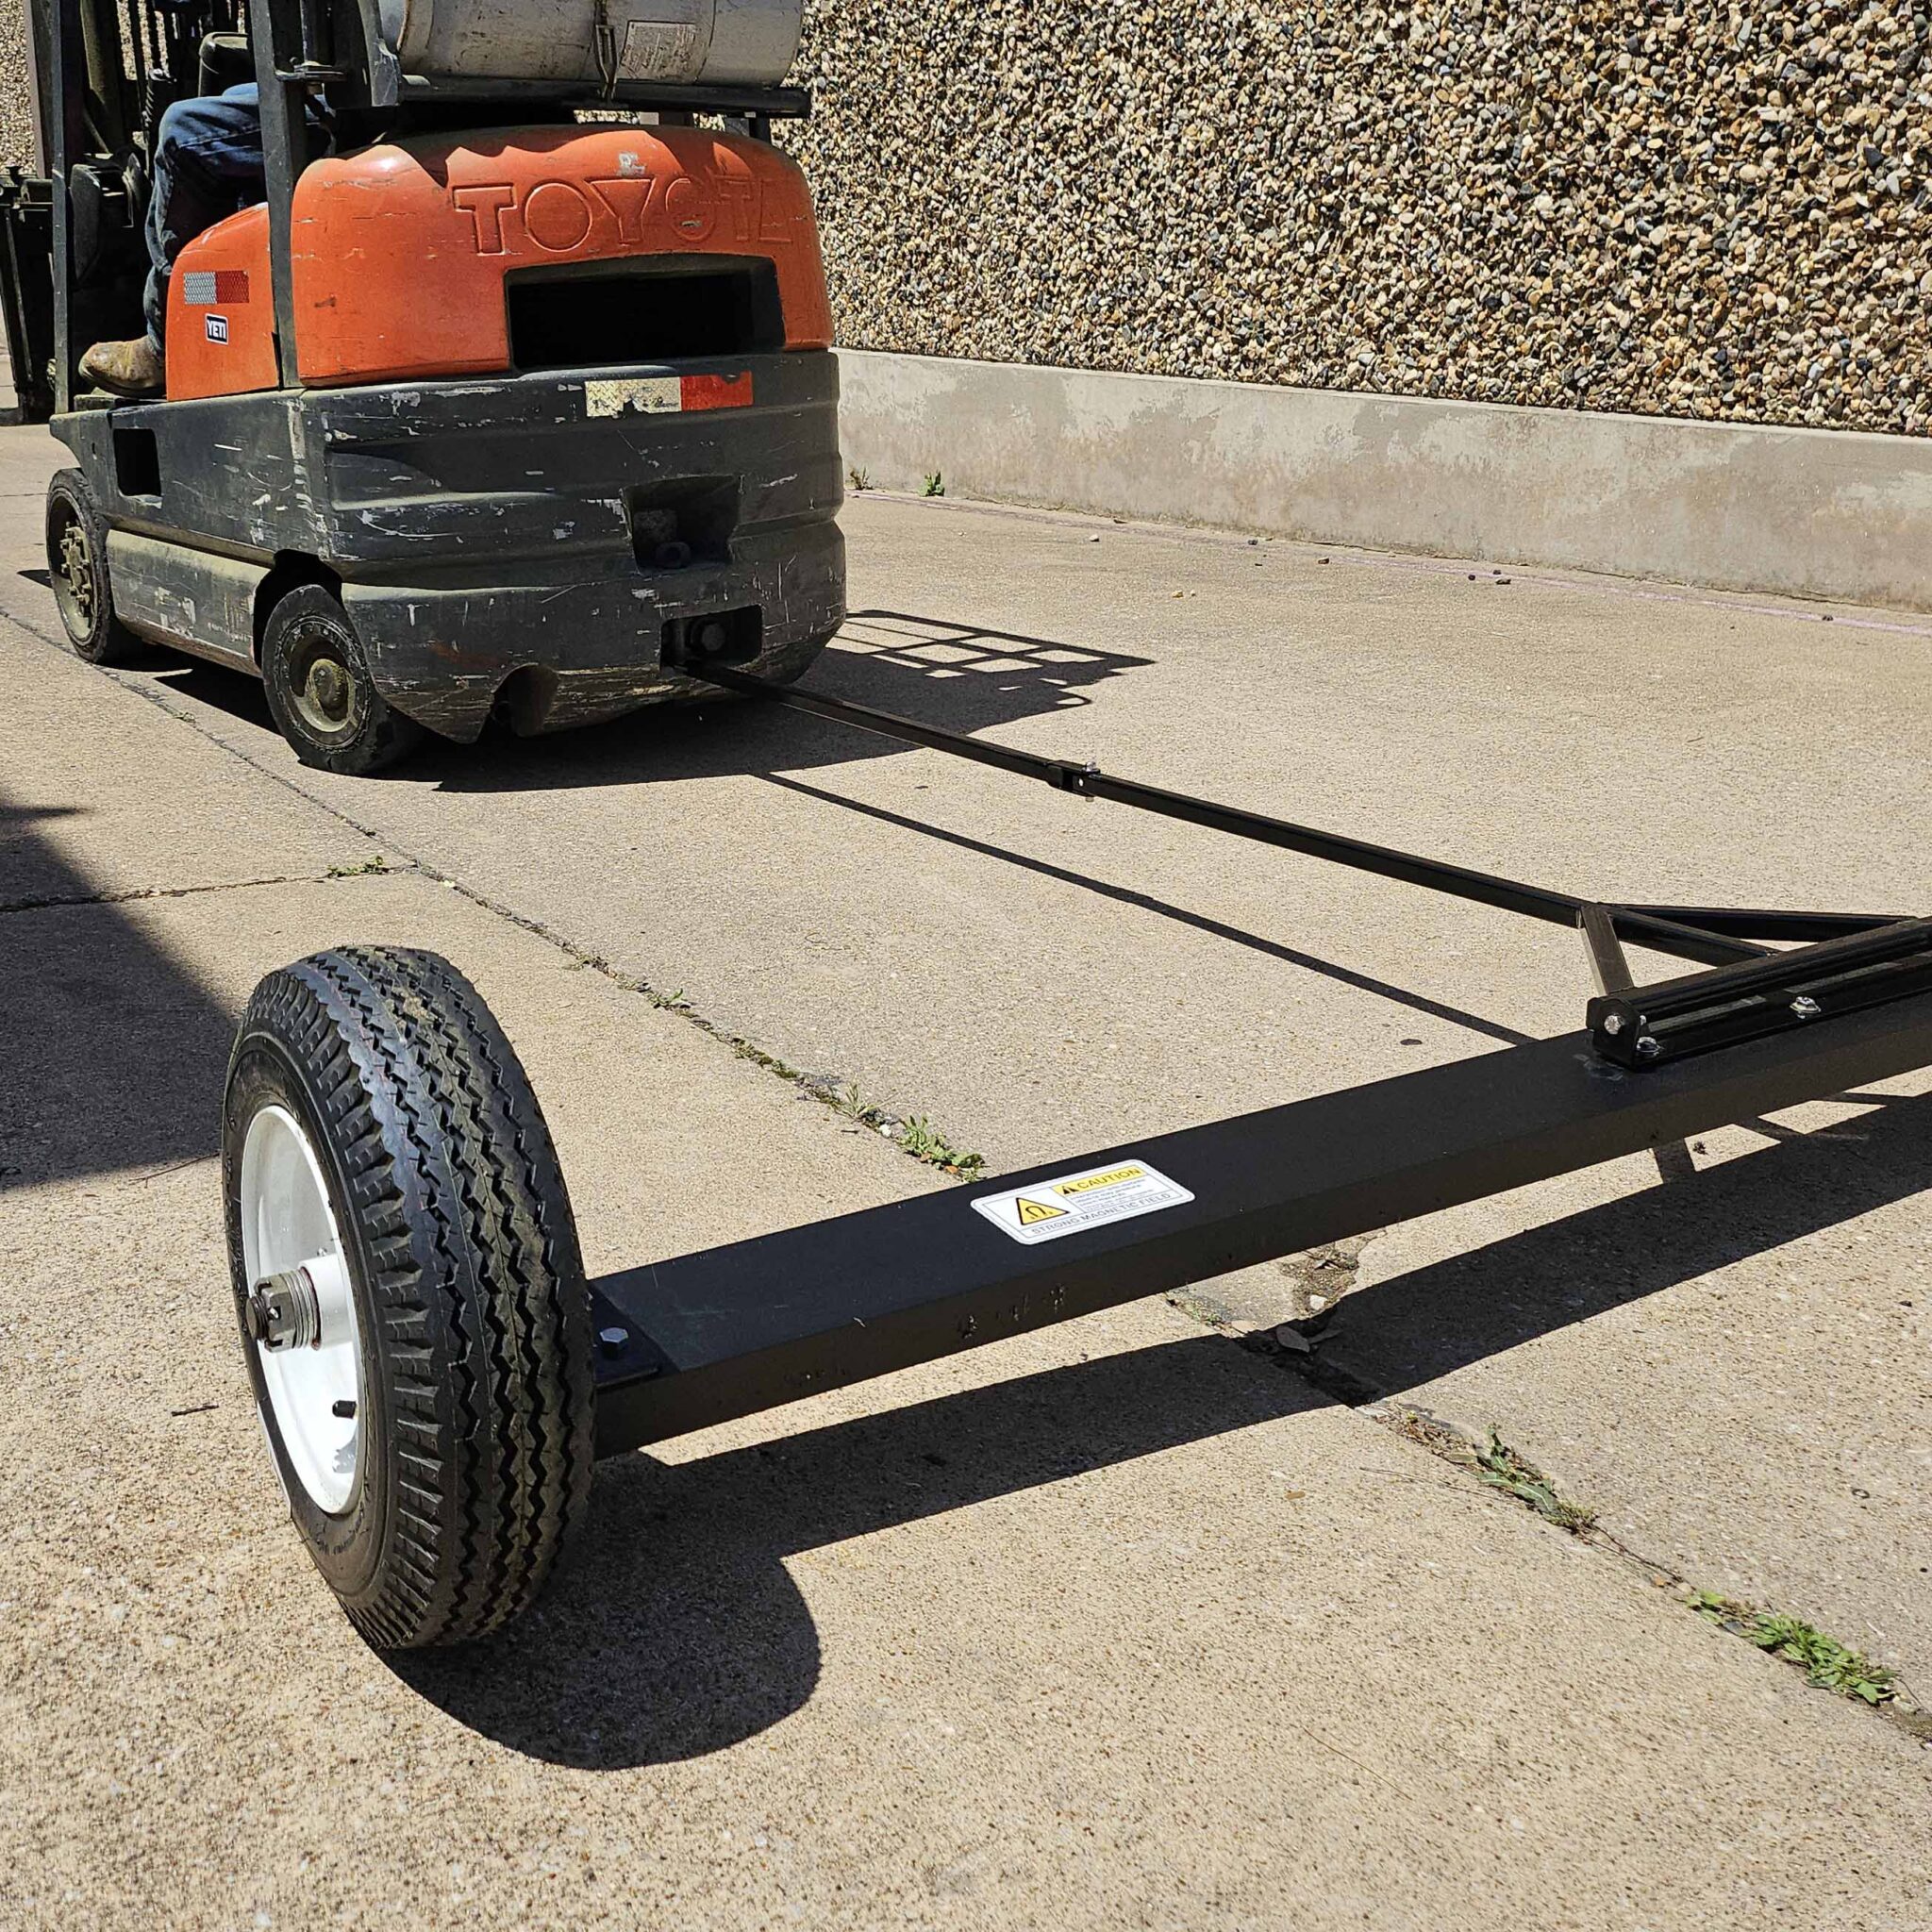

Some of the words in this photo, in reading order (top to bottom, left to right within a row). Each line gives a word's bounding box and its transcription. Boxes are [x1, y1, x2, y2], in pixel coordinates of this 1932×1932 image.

[207, 319, 226, 340] YETI
[1076, 1168, 1141, 1189] CAUTION
[1032, 1219, 1079, 1234] STRONG
[1081, 1202, 1135, 1221] MAGNETIC
[1140, 1192, 1171, 1208] FIELD
